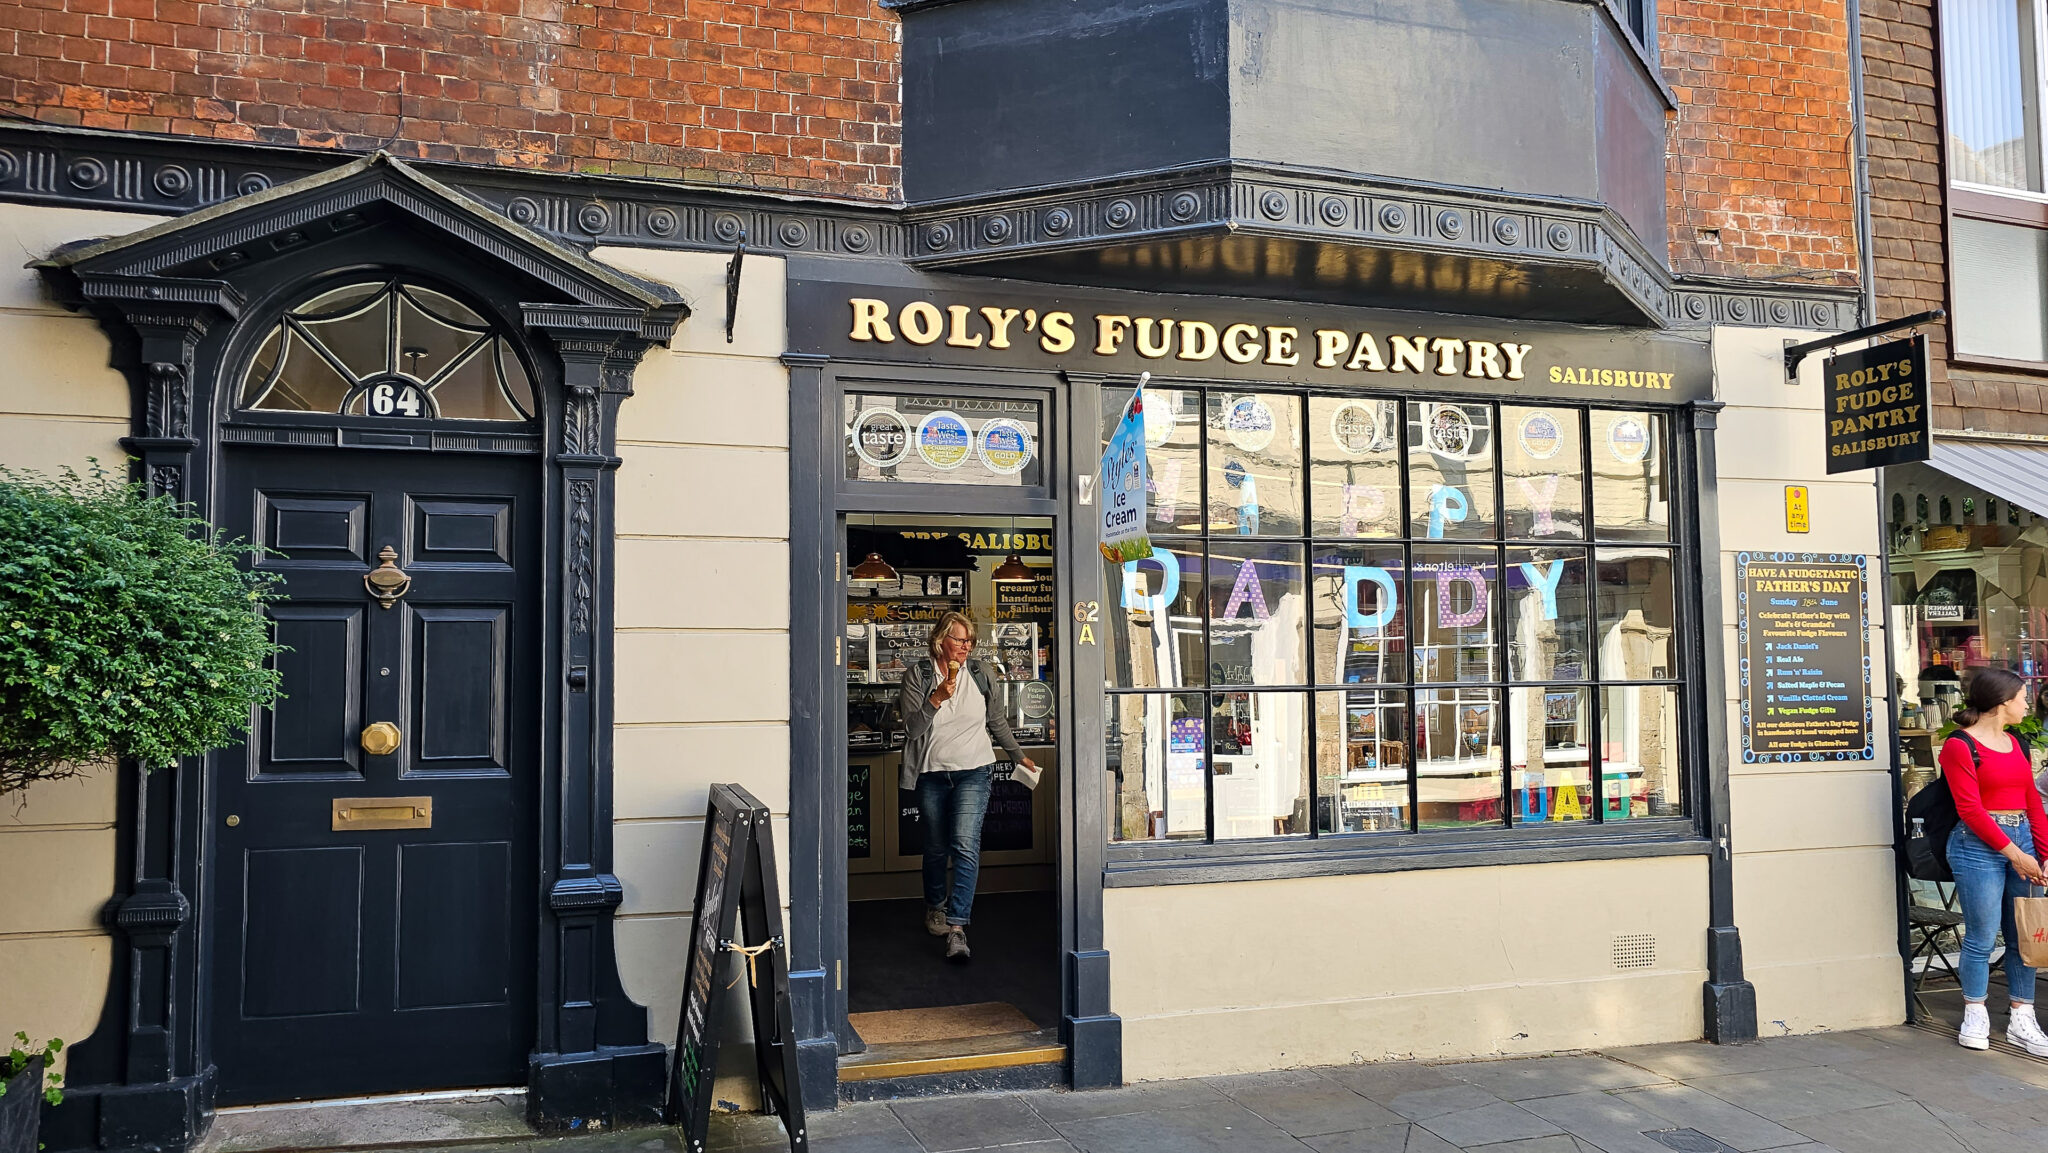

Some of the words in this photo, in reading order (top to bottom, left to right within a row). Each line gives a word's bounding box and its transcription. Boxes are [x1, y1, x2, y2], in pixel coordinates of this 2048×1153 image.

[848, 297, 1075, 355] ROLY'S
[1094, 314, 1300, 366] FUDGE
[1315, 328, 1533, 381] PANTRY
[1549, 364, 1675, 390] SALISBURY
[1835, 359, 1912, 391] ROLY'S
[372, 384, 420, 416] 64
[1836, 383, 1914, 414] FUDGE
[936, 421, 958, 429] Taste
[1831, 405, 1921, 437] PANTRY
[871, 424, 893, 433] great
[862, 431, 904, 445] taste
[937, 431, 958, 439] West
[1832, 431, 1921, 457] SALISBURY
[1113, 491, 1126, 509] Ice
[1793, 503, 1802, 511] At
[1106, 508, 1137, 529] Cream
[1792, 512, 1804, 520] any
[1790, 520, 1807, 529] time
[1748, 568, 1777, 578] HAVE
[1779, 569, 1787, 578] A
[1788, 569, 1858, 579] FUDGETASTIC
[1000, 585, 1038, 593] creamy
[1756, 580, 1820, 593] FATHER'S
[1823, 581, 1851, 593] DAY
[1770, 598, 1798, 607] Sunday
[1074, 600, 1099, 623] 62
[1792, 612, 1819, 620] Father's
[881, 630, 924, 638] Create
[1079, 624, 1096, 646] A
[1797, 630, 1817, 638] Fudge
[888, 640, 909, 648] Own
[895, 650, 908, 660] of
[1799, 682, 1818, 690] Maple
[1799, 707, 1819, 715] Fudge
[2032, 928, 2048, 943] H&
